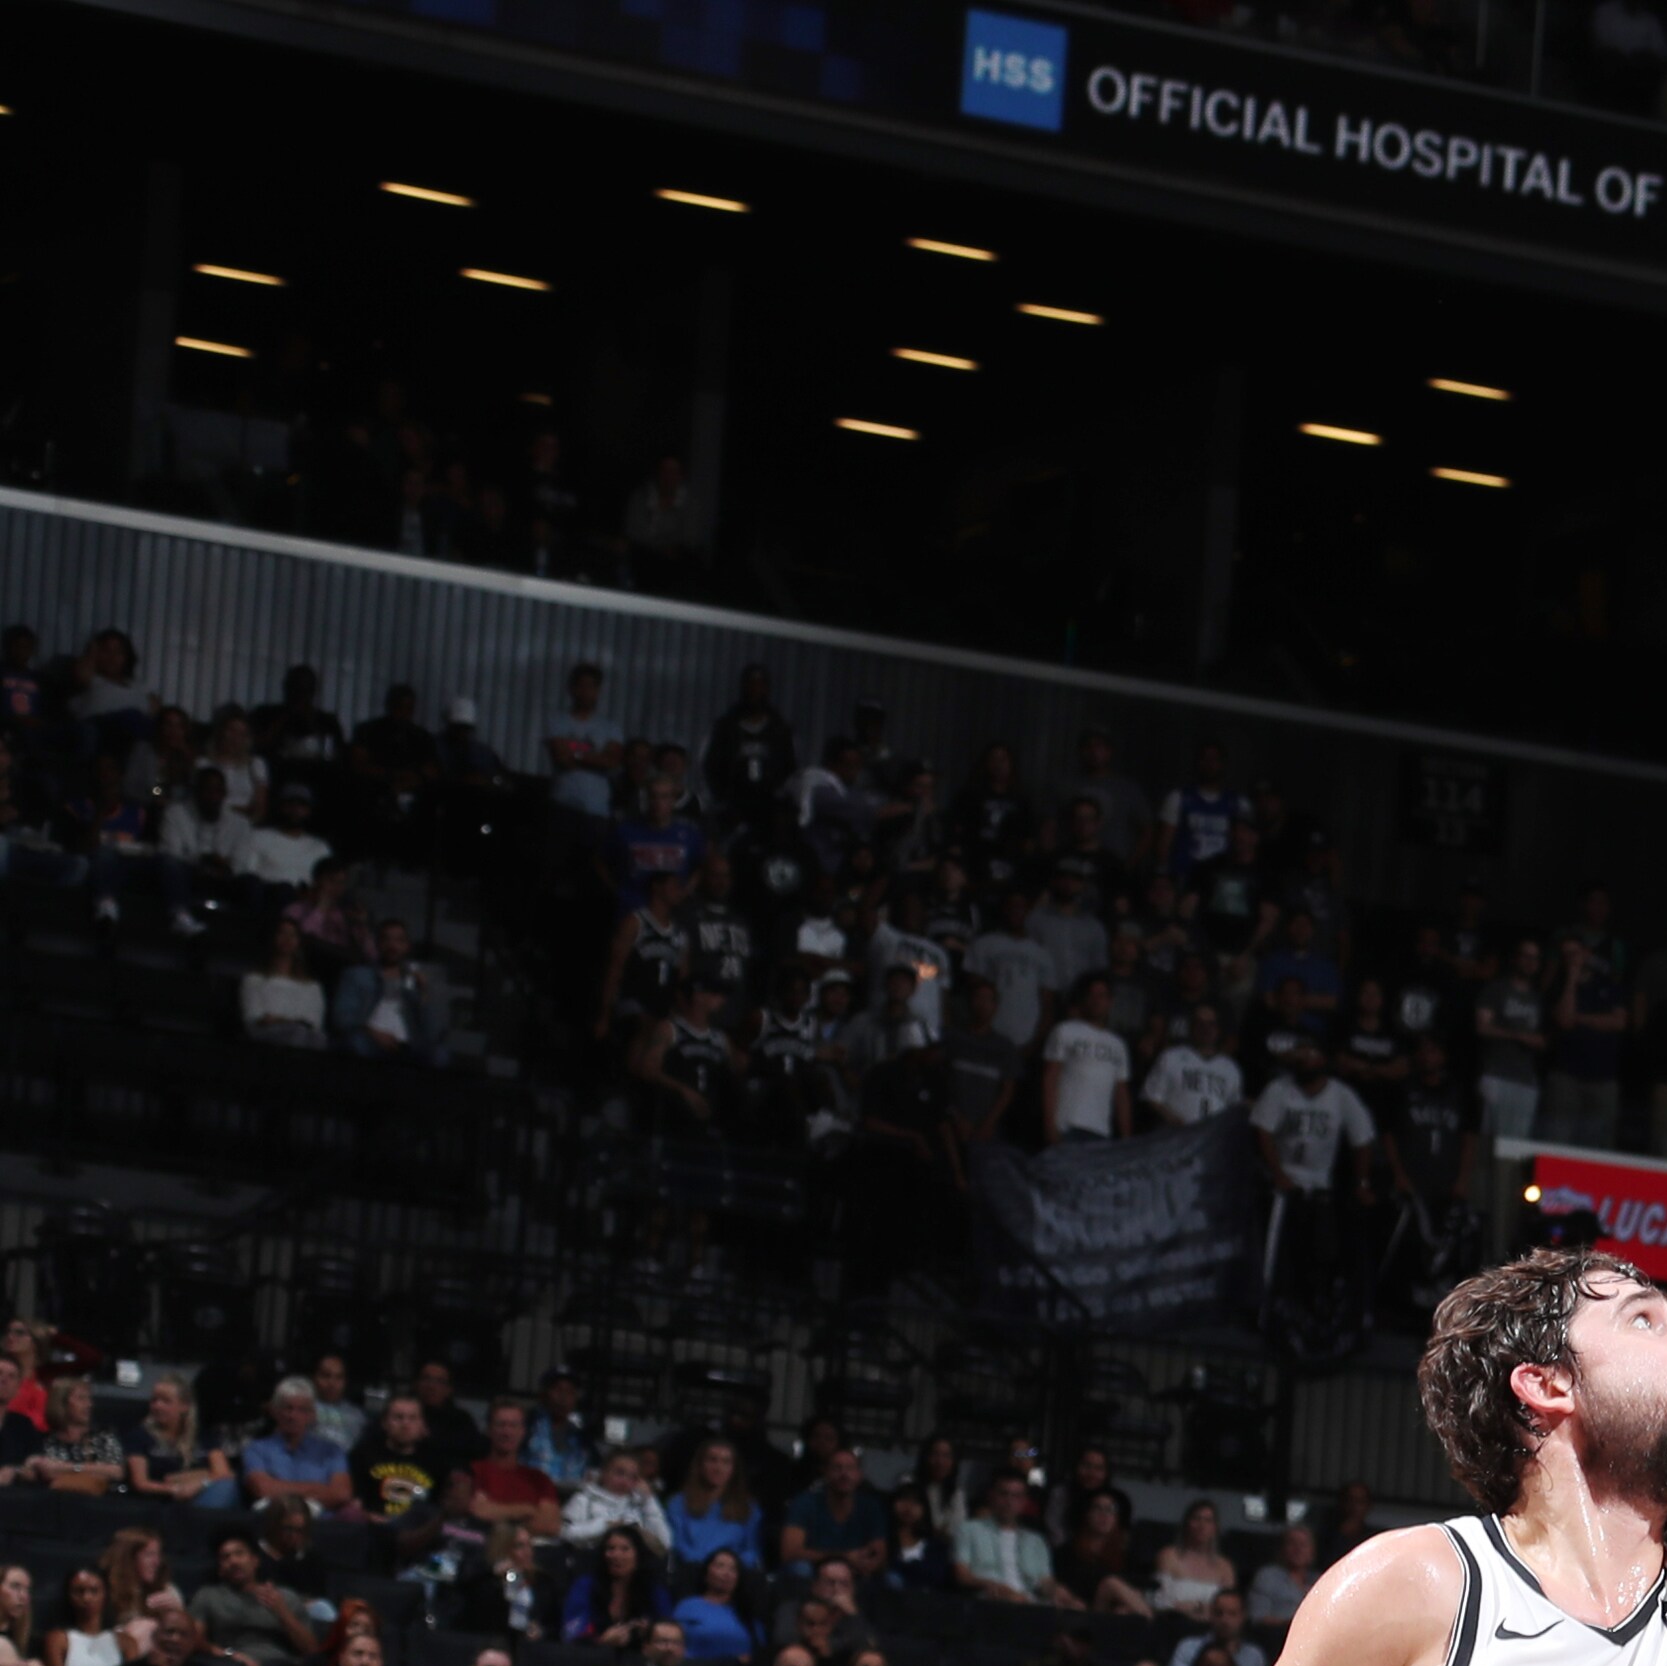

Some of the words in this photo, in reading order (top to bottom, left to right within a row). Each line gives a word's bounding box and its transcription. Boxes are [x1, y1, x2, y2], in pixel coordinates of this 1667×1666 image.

[973, 46, 1055, 94] HSS
[1086, 65, 1322, 156] OFFICIAL
[1334, 113, 1584, 206] HOSPITAL
[1595, 165, 1662, 218] OF
